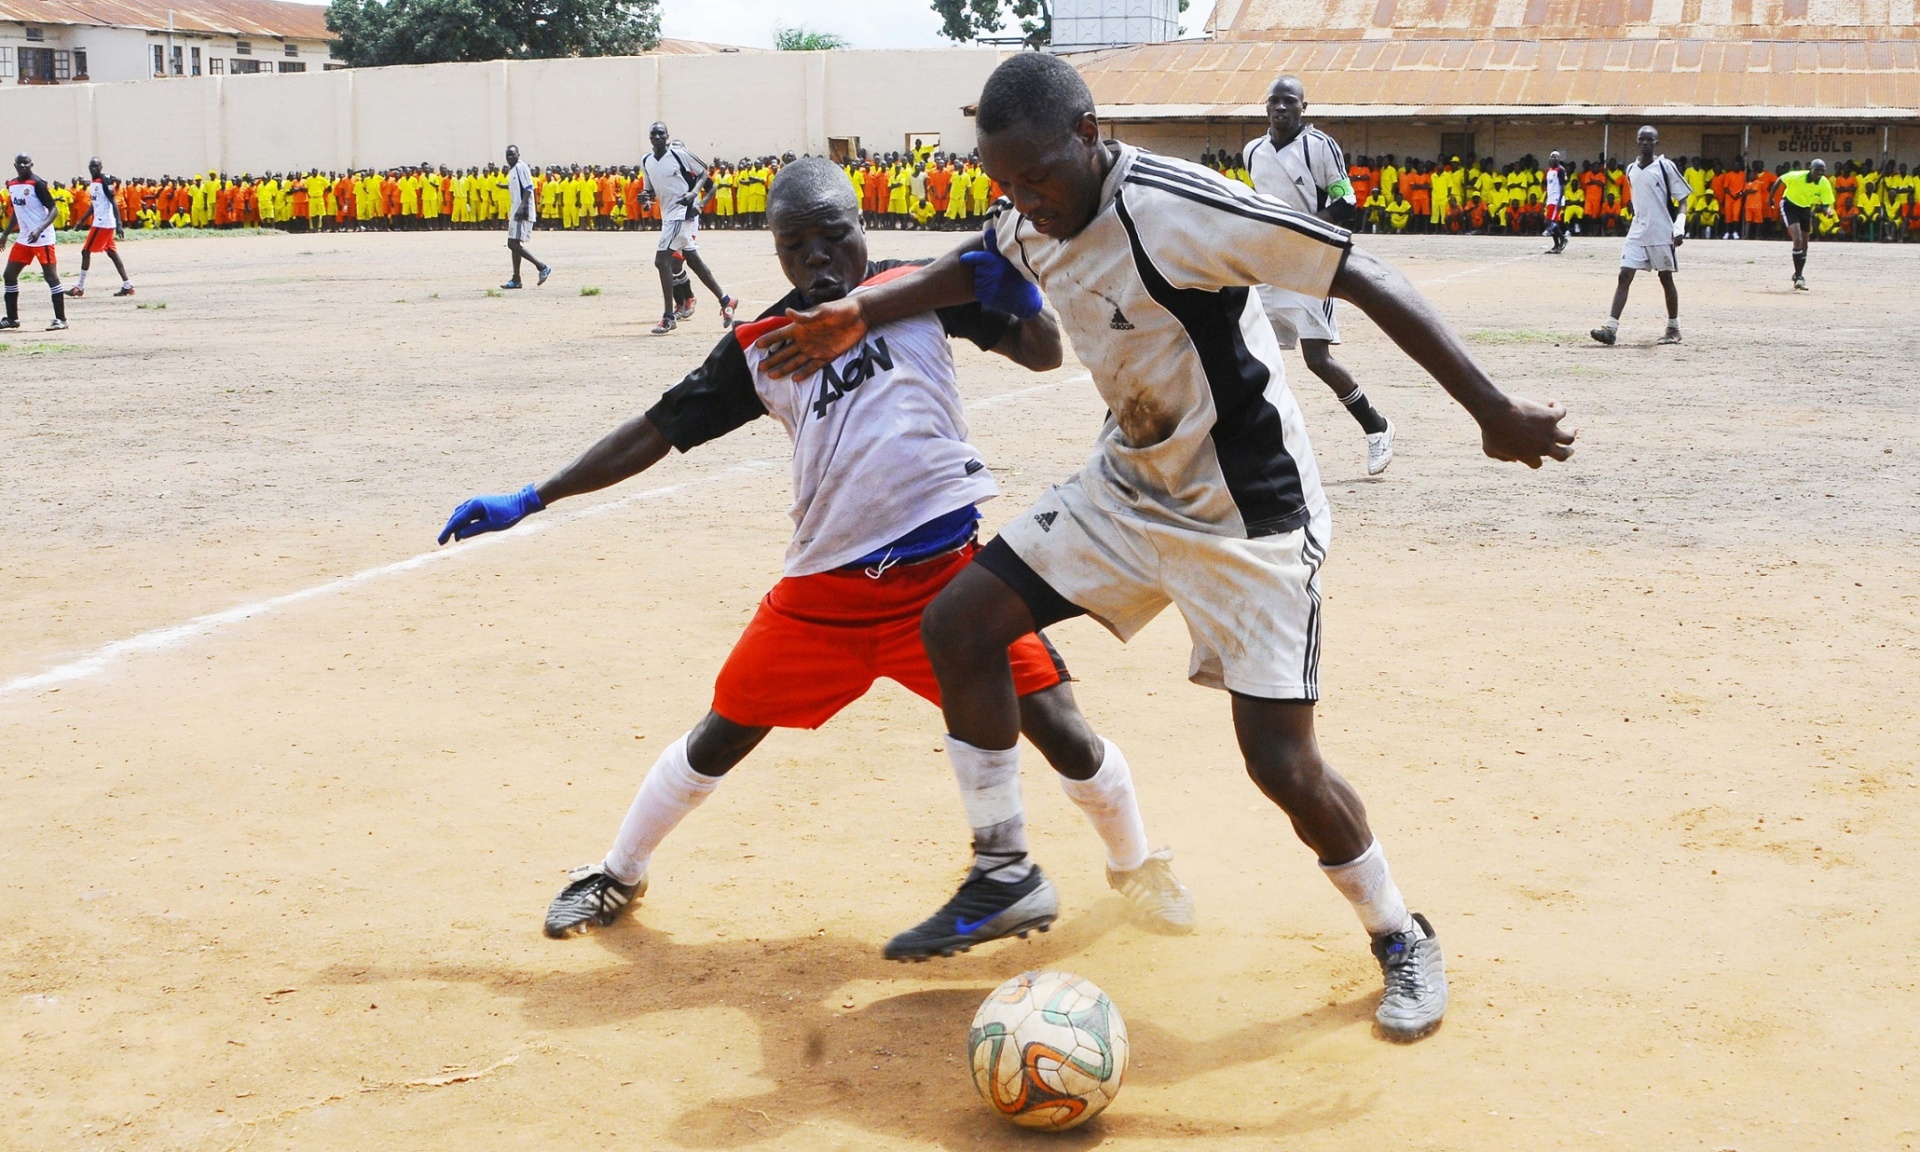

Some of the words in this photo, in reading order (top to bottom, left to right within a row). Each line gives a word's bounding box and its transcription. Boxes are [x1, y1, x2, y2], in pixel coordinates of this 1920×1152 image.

[1761, 125, 1814, 135] UPPER
[1818, 126, 1877, 136] PRISON
[1778, 140, 1852, 152] SCHOOLS
